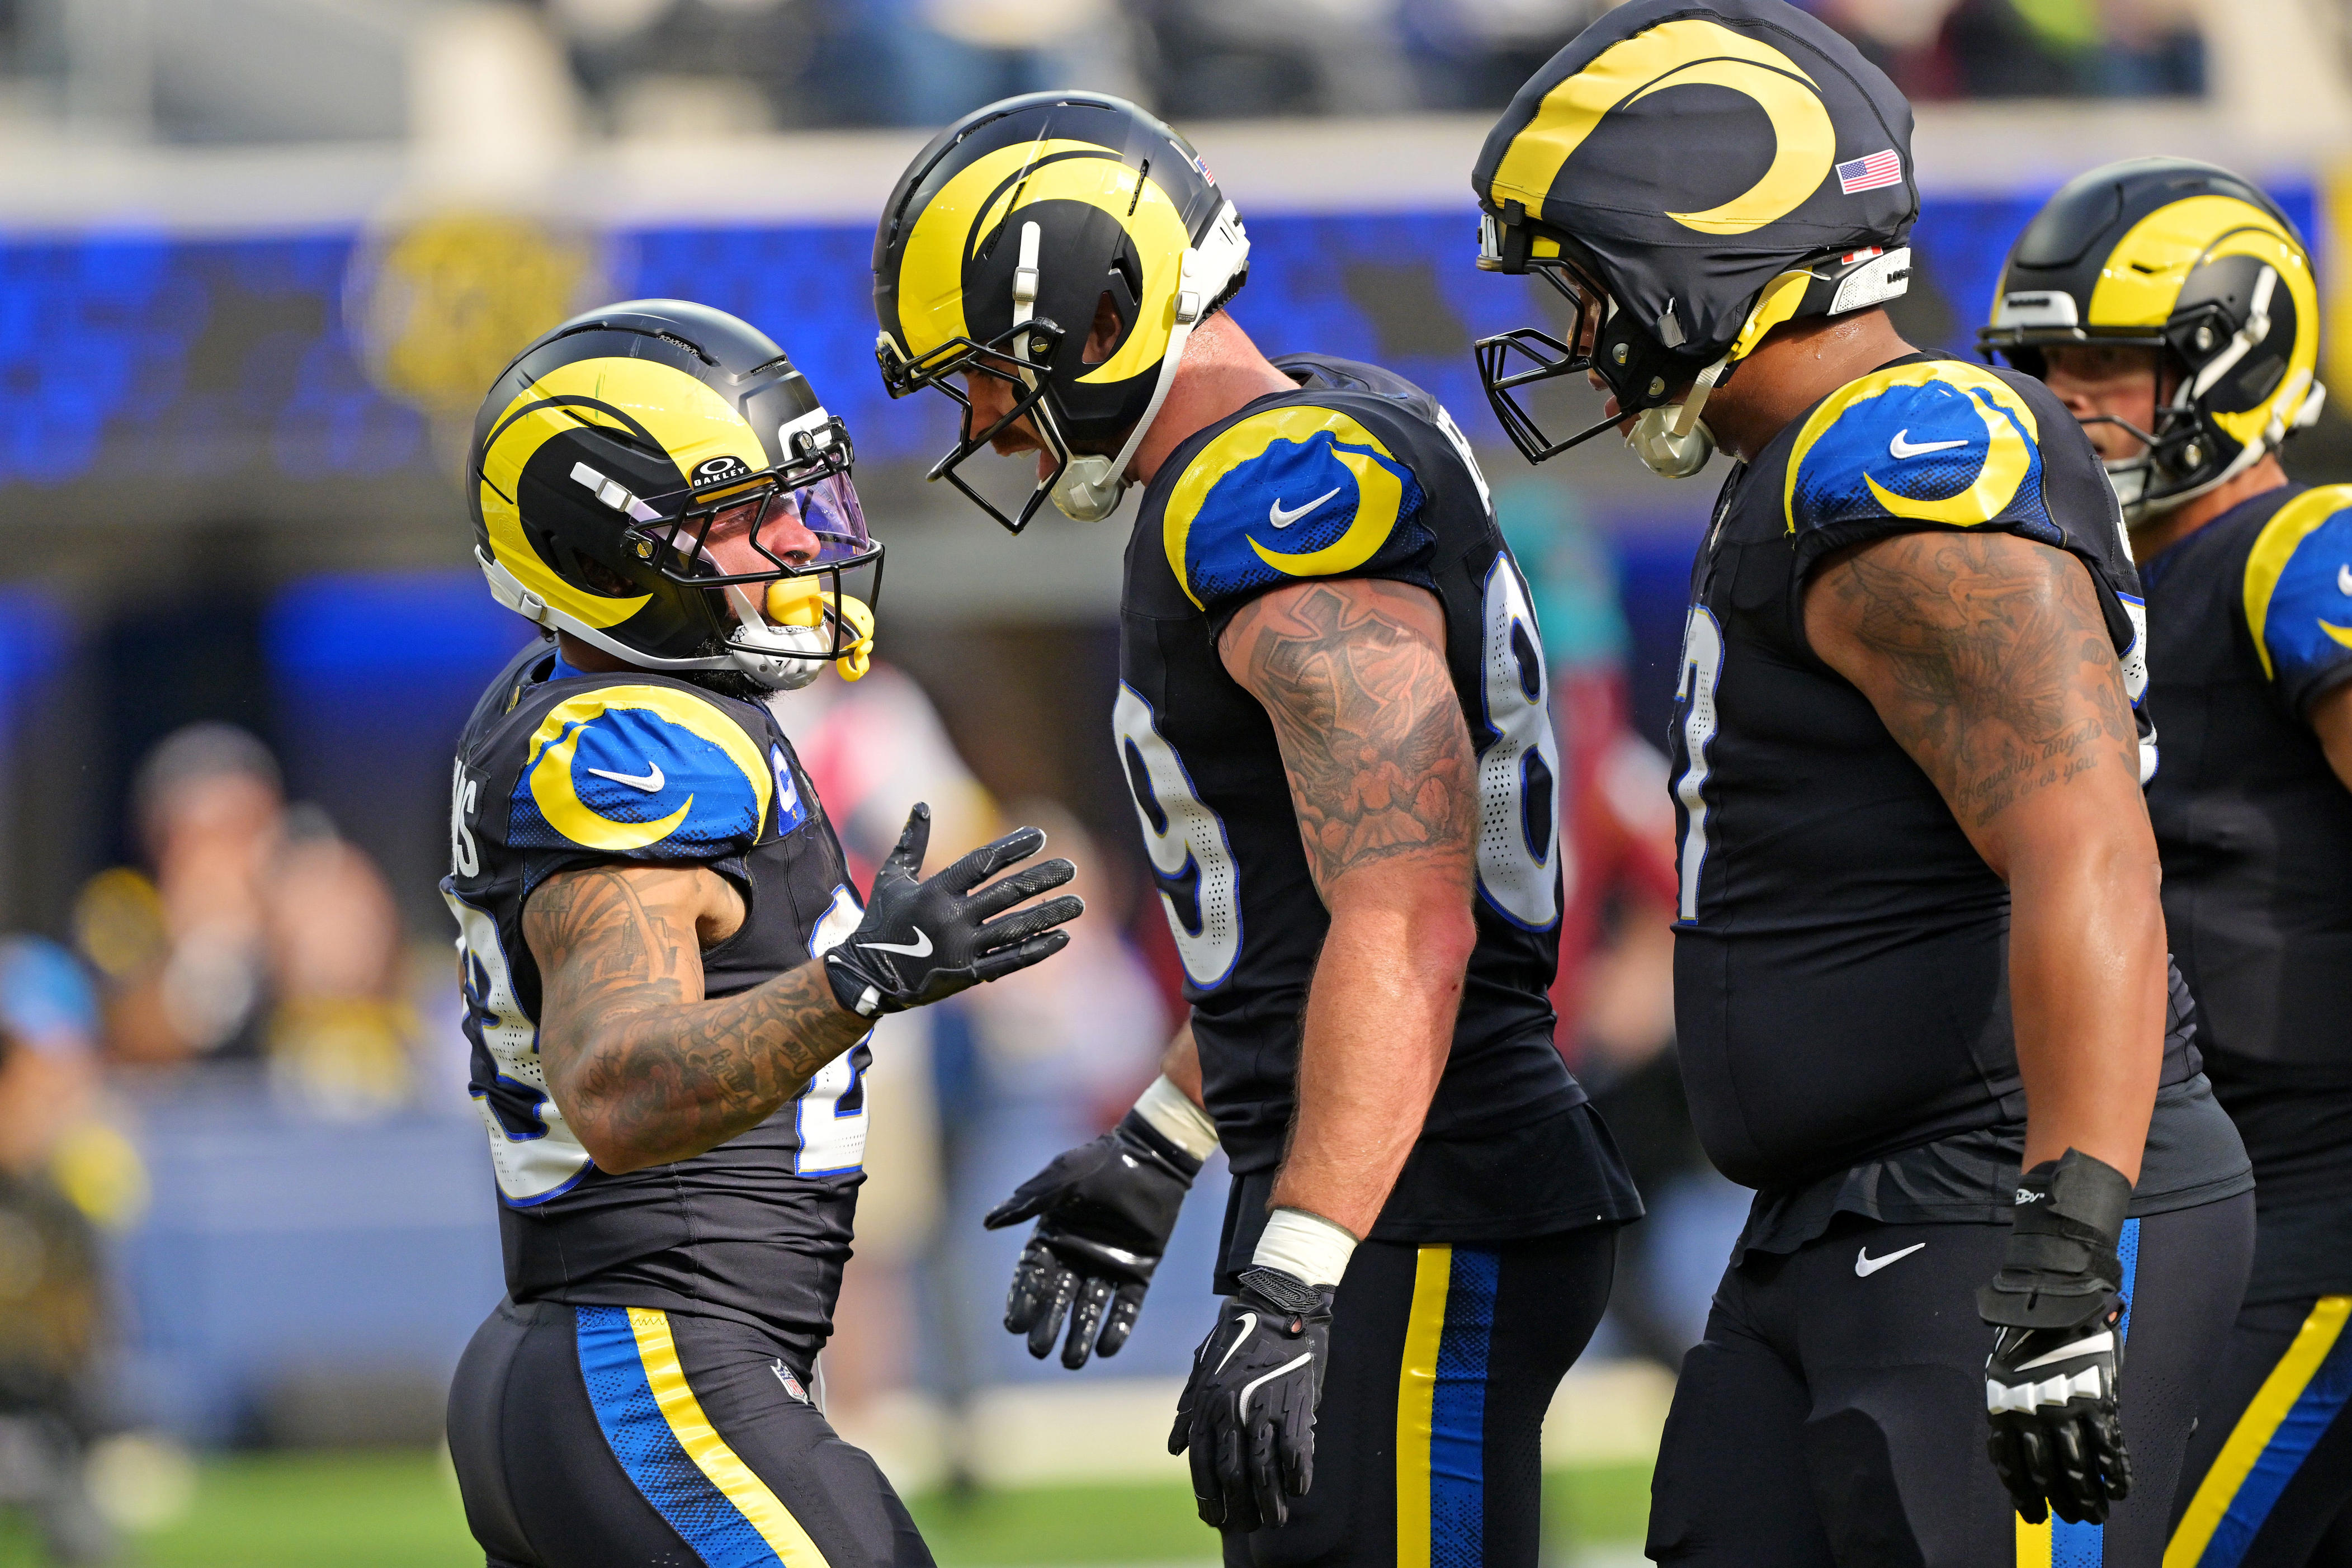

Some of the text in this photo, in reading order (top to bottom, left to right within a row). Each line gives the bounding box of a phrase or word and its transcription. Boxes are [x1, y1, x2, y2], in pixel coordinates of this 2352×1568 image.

[694, 467, 745, 486] OAKLEY
[773, 750, 797, 812] C
[1112, 678, 1243, 990] 9
